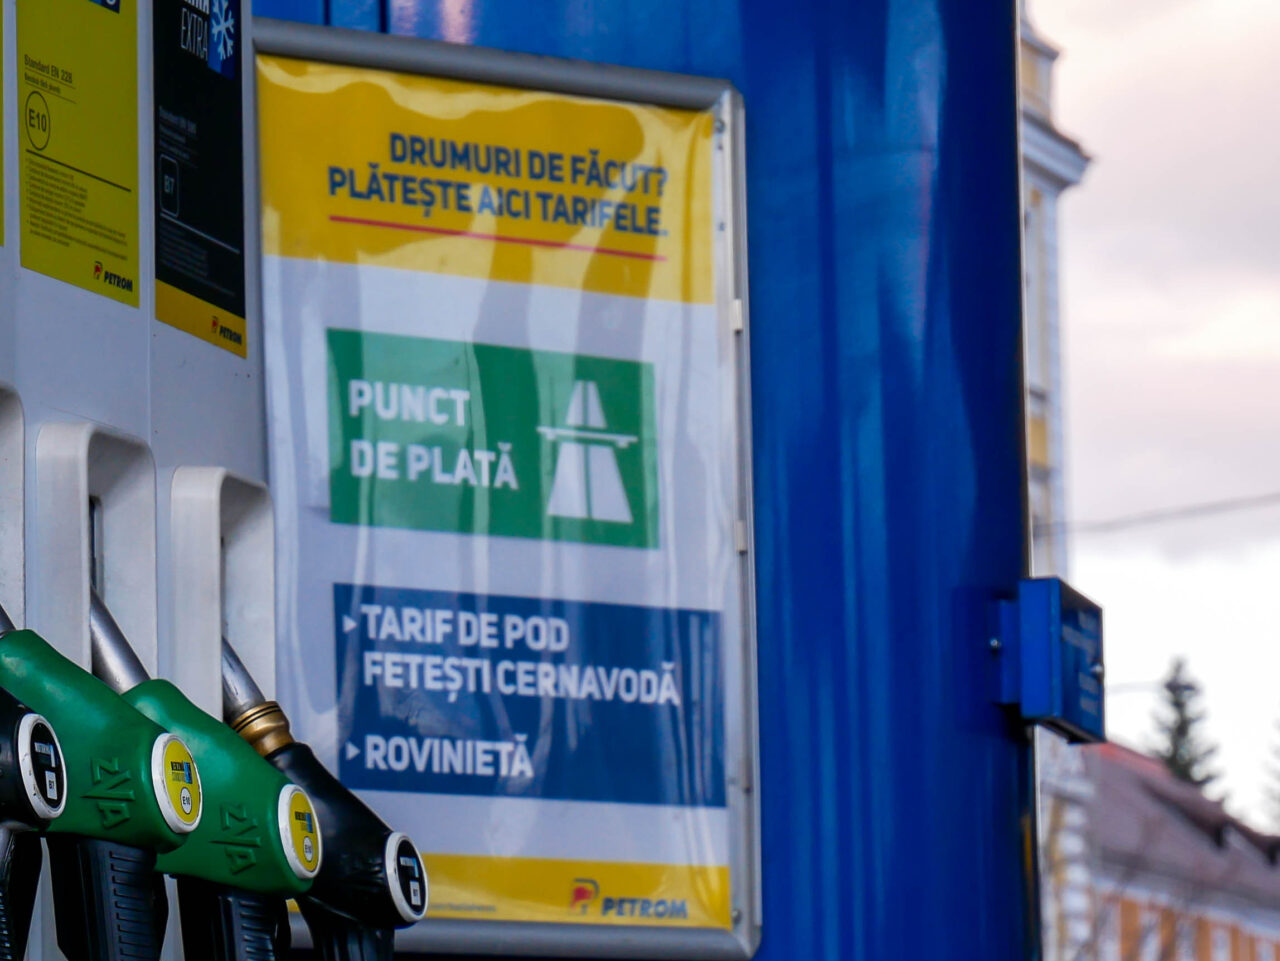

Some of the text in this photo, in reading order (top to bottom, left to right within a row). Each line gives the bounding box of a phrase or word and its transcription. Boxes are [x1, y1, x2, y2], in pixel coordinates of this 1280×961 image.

[181, 7, 208, 61] EXTRA
[24, 54, 50, 75] Standard
[28, 108, 47, 132] E10
[389, 132, 668, 197] DRUMURI DE FĂCUT?
[328, 162, 669, 237] PLĂTEȘTE AICI TARIFELE.
[104, 270, 133, 292] PETROM
[219, 325, 242, 345] PETROM
[349, 379, 471, 427] PUNCT
[350, 440, 519, 490] DE PLATĂ
[361, 603, 570, 652] TARIF DE POD
[364, 651, 681, 706] FETEȘTI CERNAVODĂ
[365, 733, 535, 779] ROVINIETĂ
[601, 896, 688, 920] PETROM
